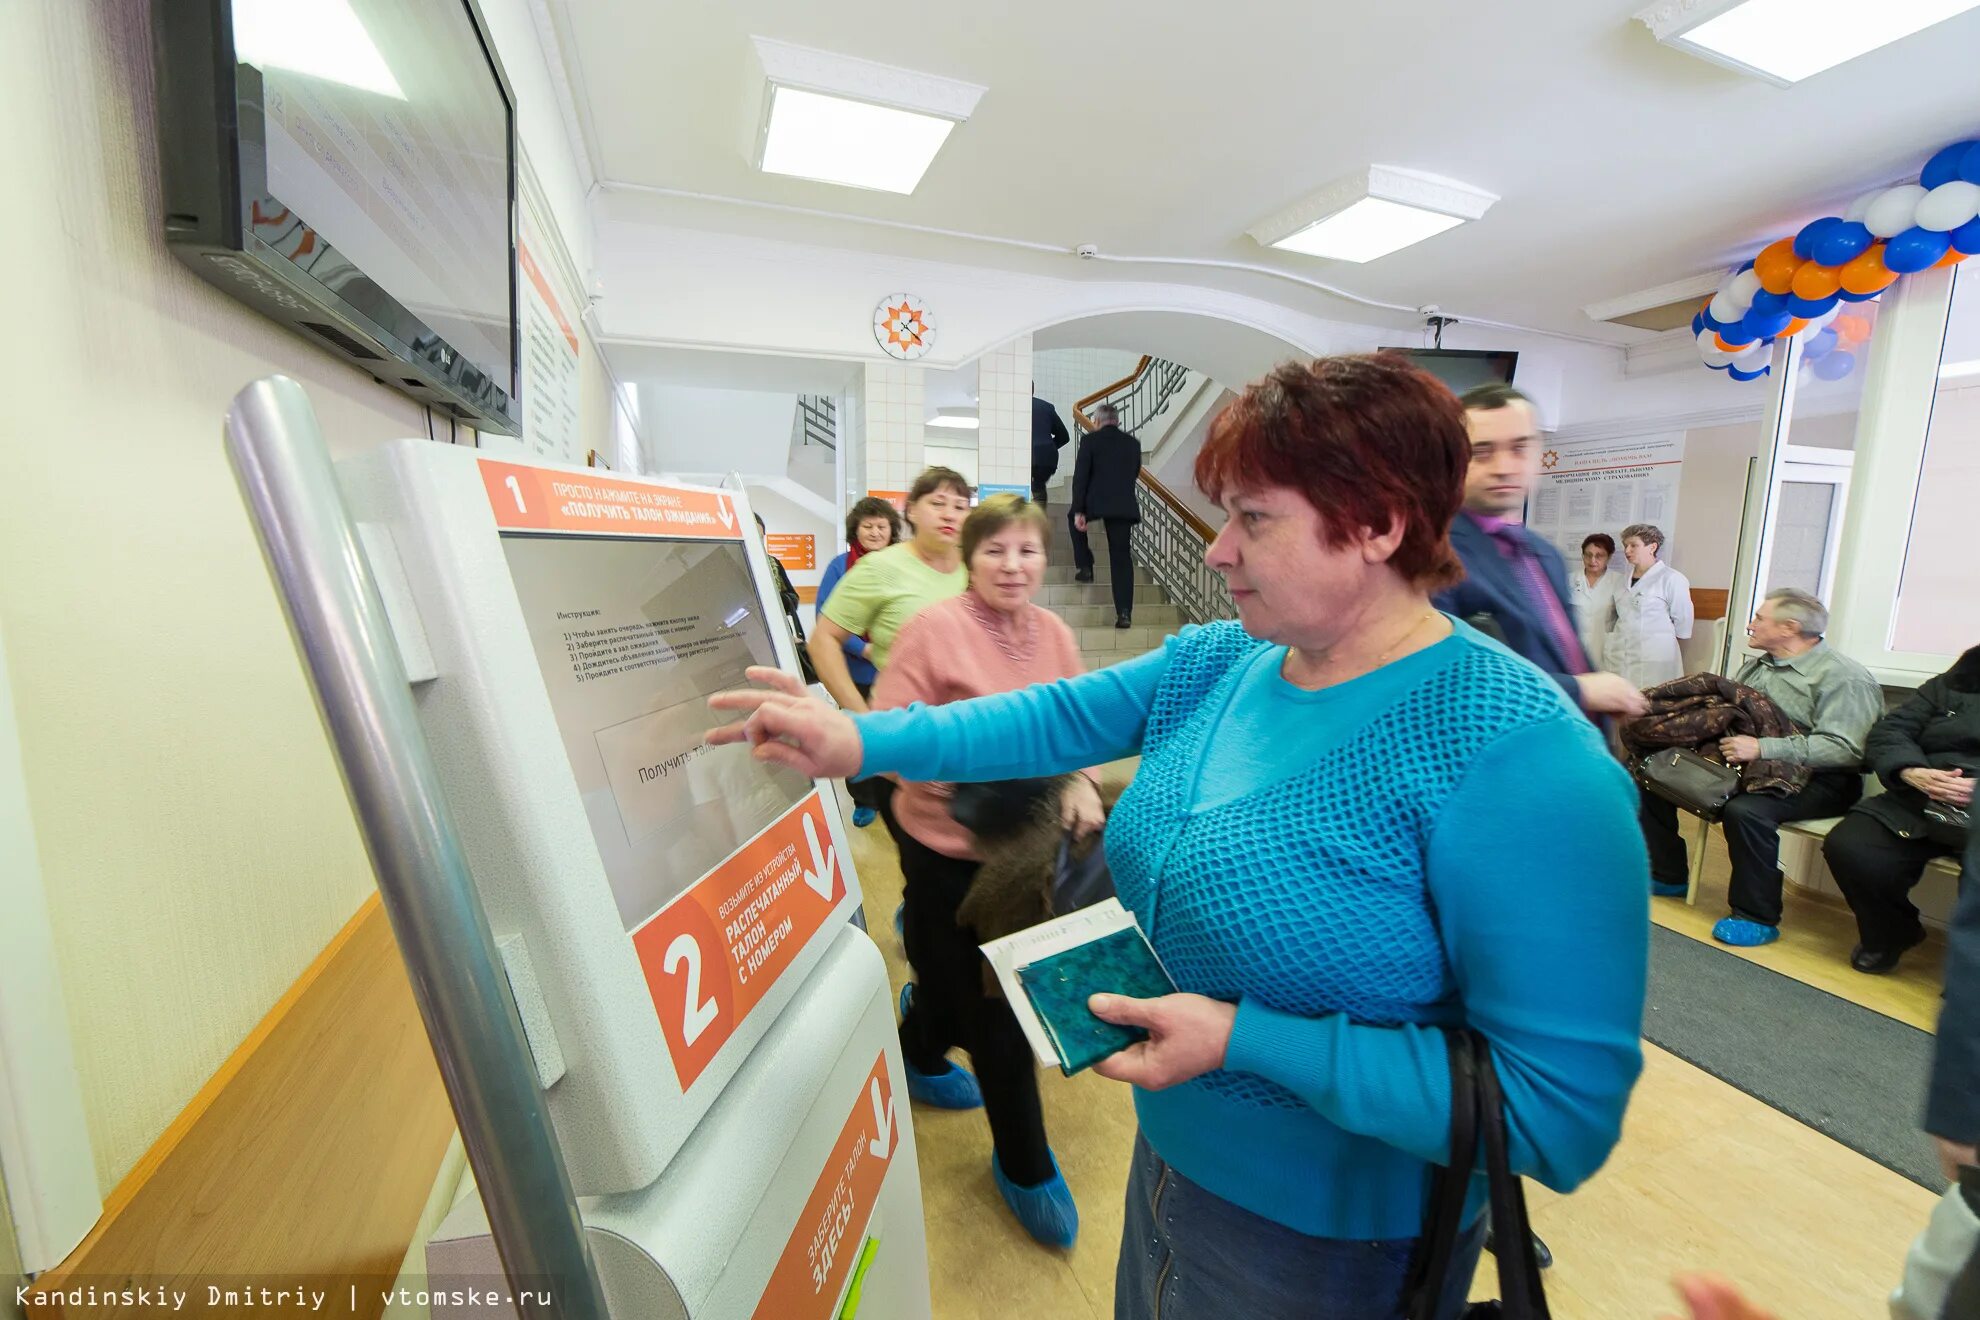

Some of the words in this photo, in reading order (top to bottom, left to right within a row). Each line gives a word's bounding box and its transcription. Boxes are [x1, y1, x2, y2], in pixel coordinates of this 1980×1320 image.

[505, 475, 527, 514] 1
[552, 482, 594, 499] ПРОСТО
[594, 487, 640, 505] НАЖМИТЕ
[640, 492, 653, 505] НА
[652, 494, 683, 507] ЭКРАНЕ
[560, 501, 631, 520] «ПОЛУЧИТЬ
[631, 506, 663, 521] ТАЛОН
[665, 509, 716, 525] ОЖИДАНИЯ»
[556, 609, 600, 619] Инструкция:
[563, 632, 572, 641] 1)
[572, 630, 596, 640] Чтобы
[596, 627, 618, 636] занять
[618, 624, 644, 633] очередь,
[669, 617, 688, 625] кнопку
[566, 643, 575, 652] 2)
[577, 639, 608, 650] Заберите
[608, 631, 654, 645] распечатанный
[655, 628, 670, 636] талон
[674, 624, 696, 633] номером
[569, 653, 578, 662] 3)
[578, 648, 613, 660] Пройдите
[630, 640, 659, 650] ожидания
[573, 663, 582, 672] 4)
[582, 657, 620, 671] Дождитесь
[575, 674, 585, 683] 5)
[585, 668, 619, 681] Пройдите
[638, 752, 692, 784] Получить
[718, 880, 755, 920] ВОЗЬМИТЕ
[753, 870, 765, 887] ИЗ
[762, 843, 797, 880] УСТРОЙСТВА
[725, 858, 803, 944] РАСПЕЧАТАННЫЙ
[731, 919, 767, 964] ТАЛОН
[737, 966, 748, 985] С
[747, 915, 794, 976] НОМЕРОМ
[663, 933, 719, 1048] 2
[807, 1174, 847, 1267] ЗАБЕРИТЕ
[844, 1128, 867, 1182] ТАЛОН
[812, 1187, 856, 1295] ЗДЕСЬ!
